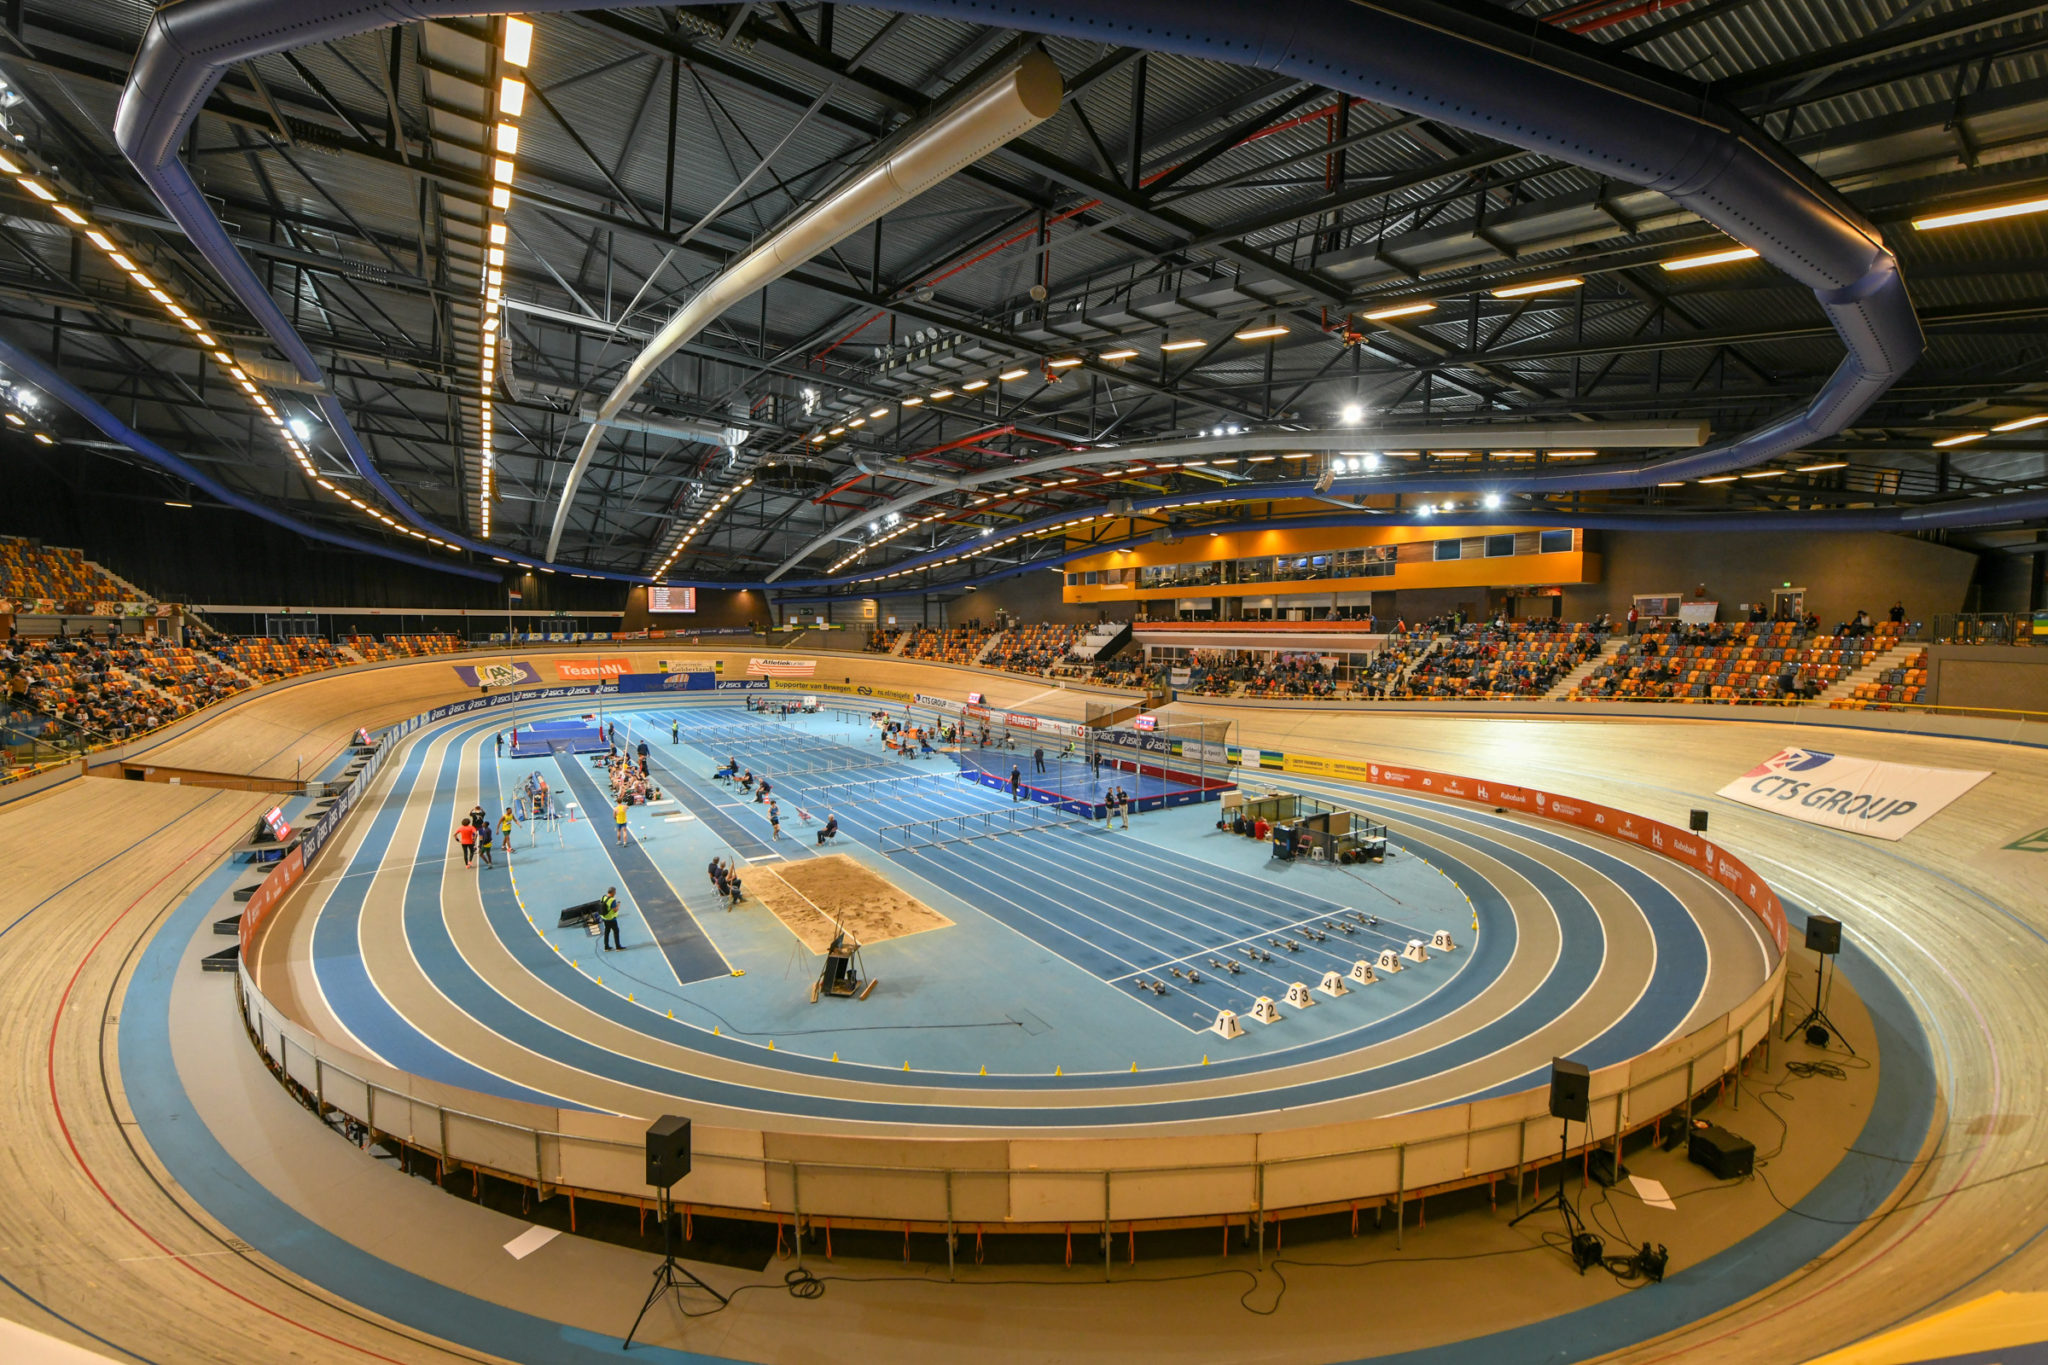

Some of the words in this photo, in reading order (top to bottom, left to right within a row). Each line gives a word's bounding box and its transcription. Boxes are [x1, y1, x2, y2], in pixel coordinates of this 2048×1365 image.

[560, 664, 627, 676] TeamNL
[775, 681, 808, 690] Supporter
[824, 683, 851, 693] Bewegen
[922, 696, 931, 704] CTS
[931, 697, 947, 707] GROUP
[1071, 725, 1091, 738] NOS
[1500, 791, 1526, 803] Rabobank
[1750, 775, 1811, 801] CTS
[1800, 785, 1918, 823] GROUP
[1673, 839, 1697, 857] Rabobank
[1435, 935, 1443, 945] 8
[1408, 945, 1417, 956] 7
[1381, 955, 1389, 966] 6
[1392, 955, 1399, 967] 6
[1354, 966, 1363, 978] 5
[1366, 967, 1373, 979] 5
[1324, 978, 1332, 989] 4
[1335, 979, 1342, 990] 4
[1289, 989, 1298, 1000] 3
[1302, 989, 1309, 1002] 3
[1255, 1004, 1264, 1016] 2
[1268, 1004, 1275, 1017] 2
[1219, 1017, 1224, 1030] 1
[1230, 1019, 1236, 1032] 1
